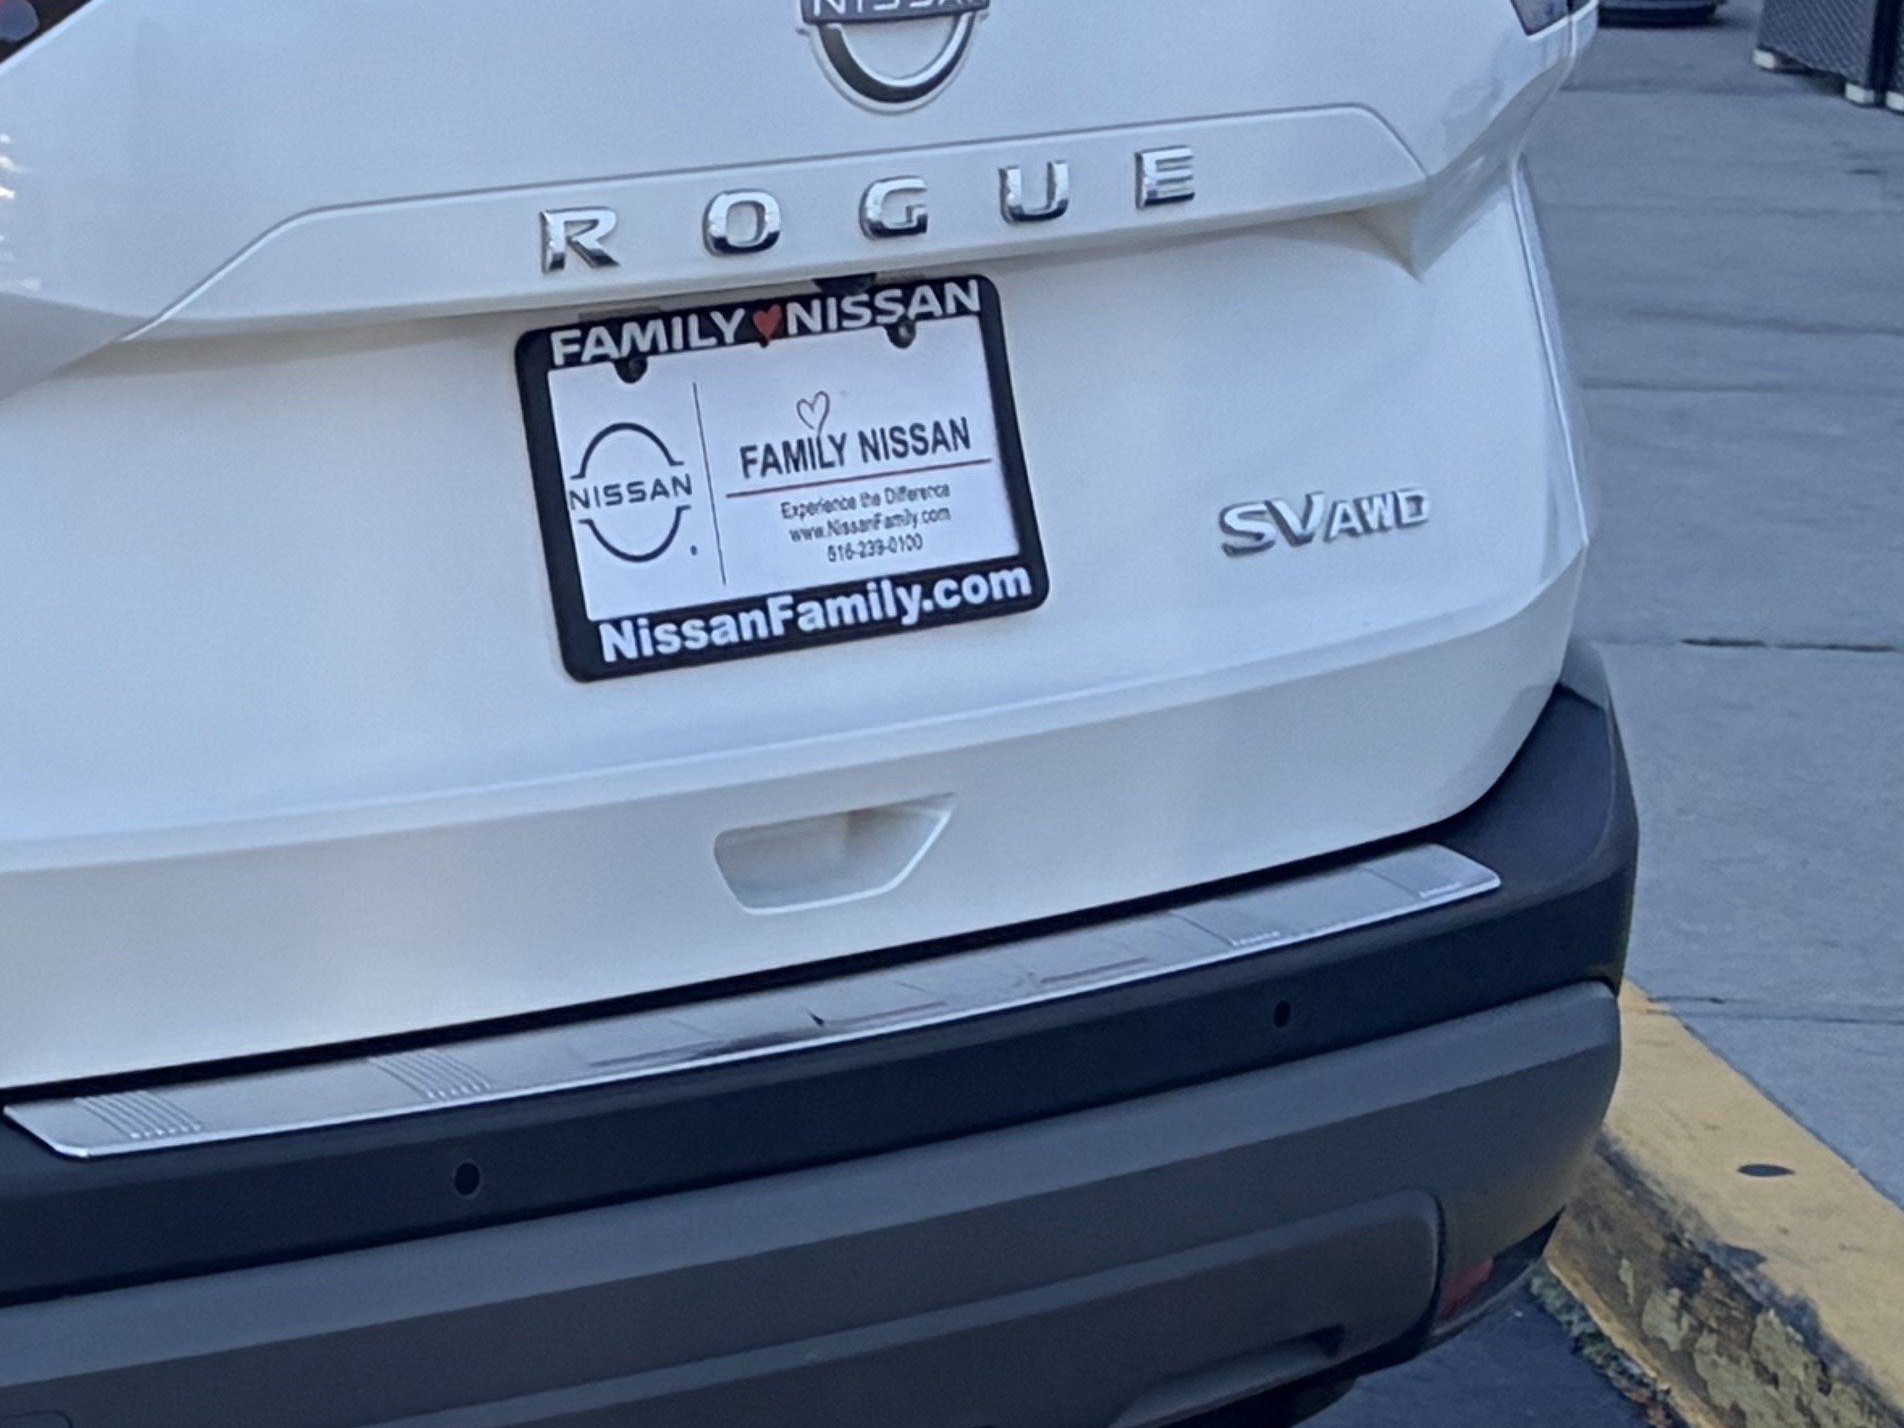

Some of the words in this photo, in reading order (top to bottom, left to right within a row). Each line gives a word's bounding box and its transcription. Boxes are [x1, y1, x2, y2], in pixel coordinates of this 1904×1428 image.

[539, 145, 1195, 274] ROGUE
[549, 307, 746, 367] FAMILY
[786, 278, 983, 336] NISSAN
[739, 430, 848, 480] FAMILY
[857, 416, 972, 464] NISSAN
[568, 473, 693, 512] NISSAN
[780, 495, 857, 521] Experience
[1219, 489, 1325, 559] SV
[1323, 486, 1434, 543] AWD
[598, 565, 1033, 665] NissanFamily.com
